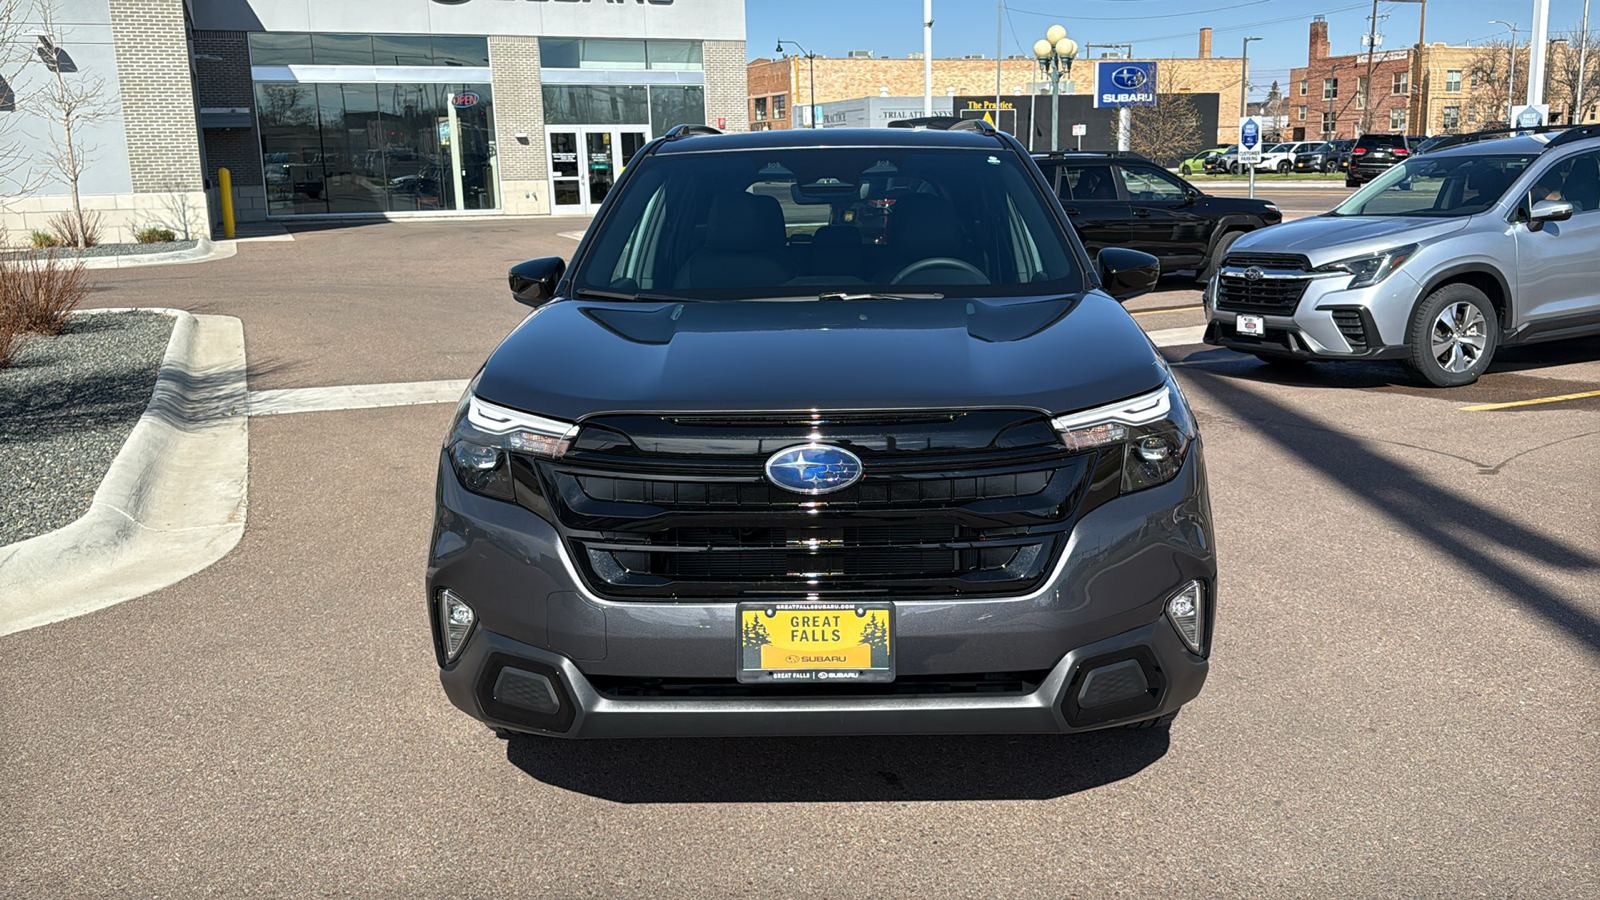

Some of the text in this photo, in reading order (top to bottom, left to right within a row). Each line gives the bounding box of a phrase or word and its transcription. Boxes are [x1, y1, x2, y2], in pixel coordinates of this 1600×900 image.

[452, 95, 477, 105] OPEN
[1102, 93, 1152, 103] SUBARU
[967, 100, 1013, 109] The Pratice
[883, 110, 953, 119] TRIAL ATTNEYS
[791, 616, 840, 627] GREAT
[791, 629, 840, 642] FALLS
